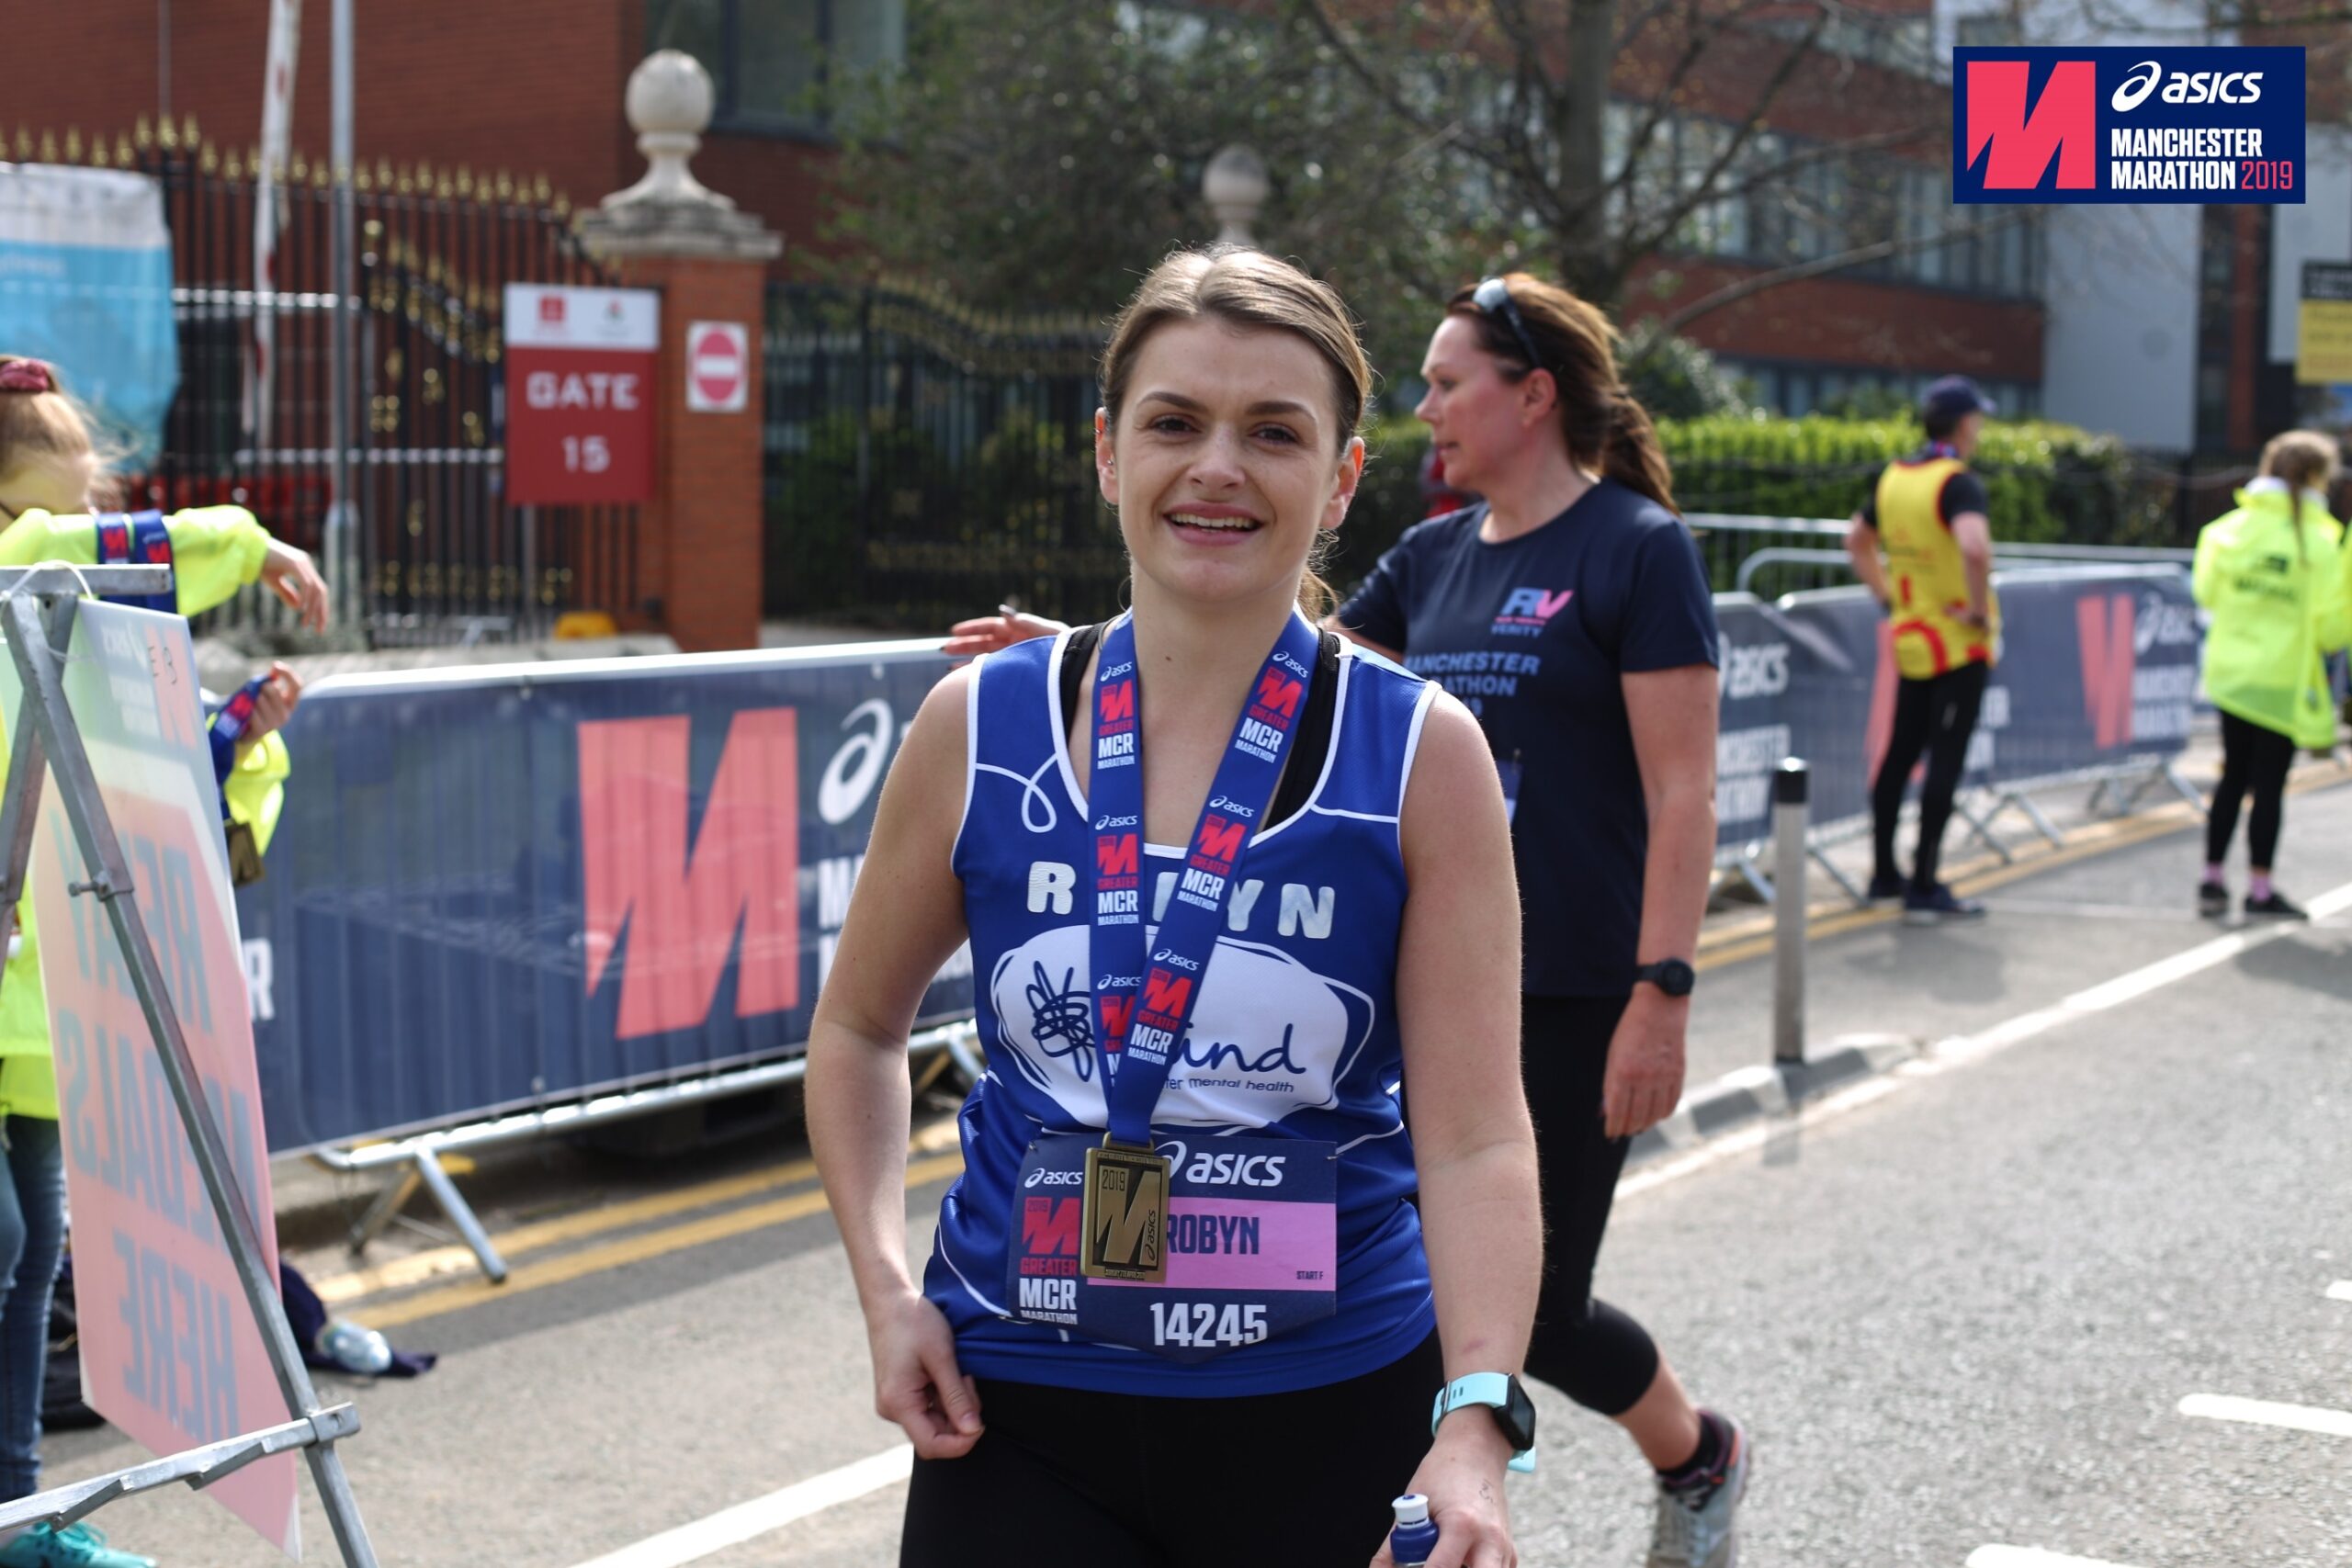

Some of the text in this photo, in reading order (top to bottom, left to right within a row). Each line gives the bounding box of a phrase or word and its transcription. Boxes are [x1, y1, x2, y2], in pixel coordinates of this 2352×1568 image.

[526, 372, 639, 410] GATE
[562, 435, 610, 473] 15
[1438, 673, 1518, 697] ATHON
[1098, 733, 1135, 759] MCR
[1238, 717, 1284, 752] MCR
[1097, 755, 1136, 770] MARATHON
[1234, 739, 1277, 763] MARATHON
[1181, 867, 1226, 900] MCR
[1027, 861, 1336, 940] RYN
[1097, 890, 1139, 915] MCR
[1177, 890, 1219, 912] MARATHON
[1097, 914, 1140, 926] MARATHON
[1130, 1023, 1174, 1054] MCR
[1173, 1022, 1306, 1075] ind
[1127, 1046, 1168, 1066] MARATHON
[1189, 1077, 1240, 1089] mental
[1245, 1079, 1295, 1093] health
[1102, 1169, 1125, 1191] 2019
[1167, 1213, 1260, 1255] ROBYN
[1020, 1257, 1078, 1276] GREATER
[1296, 1270, 1324, 1280] START F
[1019, 1278, 1078, 1311] MCR
[1020, 1310, 1079, 1325] MARATHON
[1149, 1303, 1269, 1348] 14245
